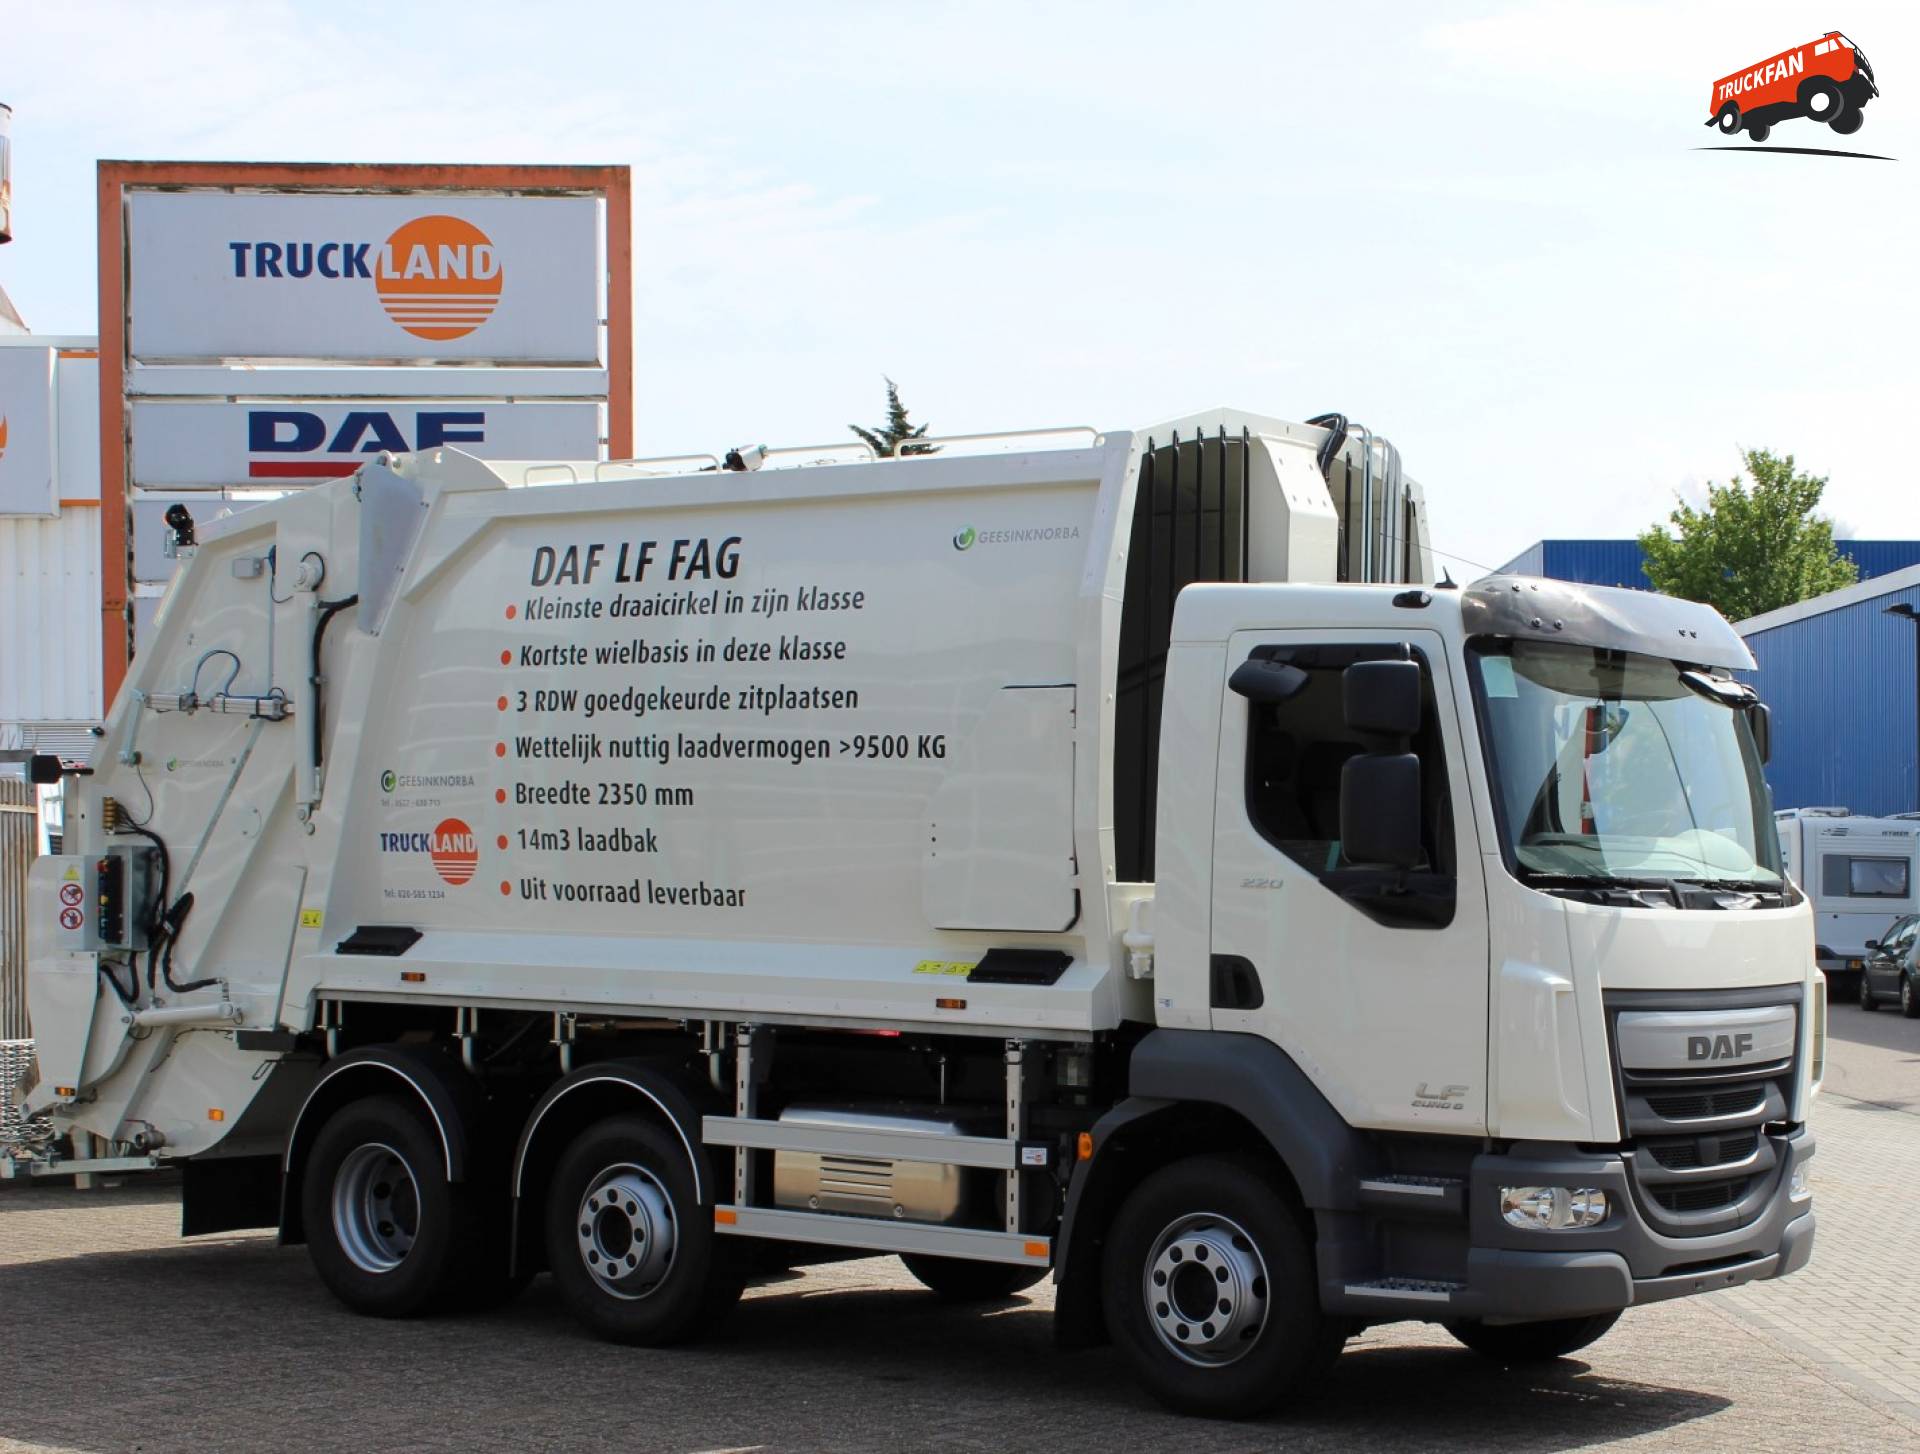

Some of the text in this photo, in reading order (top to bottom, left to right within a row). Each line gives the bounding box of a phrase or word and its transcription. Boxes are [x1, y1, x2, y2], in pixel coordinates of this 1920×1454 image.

[230, 242, 499, 279] TRUCKLAND
[248, 411, 486, 453] DAF
[978, 526, 1080, 544] GEESINKNORBA
[531, 537, 742, 587] DAF LF FAG
[524, 586, 865, 621] Kleinste draaicirkel in zijn klasse
[520, 635, 846, 666] Kortste wielbasis in deze klasse
[516, 684, 859, 718] 3 RDW goedgekeurde zitplaatsen
[516, 733, 946, 765] Wettelijk nuttig laadvermogen >9500 KG
[399, 776, 474, 787] GEESINKNORBA
[516, 781, 694, 806] Breedte 2350 mm
[381, 833, 475, 852] TRUCKLAND
[517, 826, 658, 853] 14m3 laadbak
[520, 878, 746, 907] Uit voorraad leverbaar
[1687, 1033, 1753, 1060] DAF
[1415, 1082, 1470, 1100] LF
